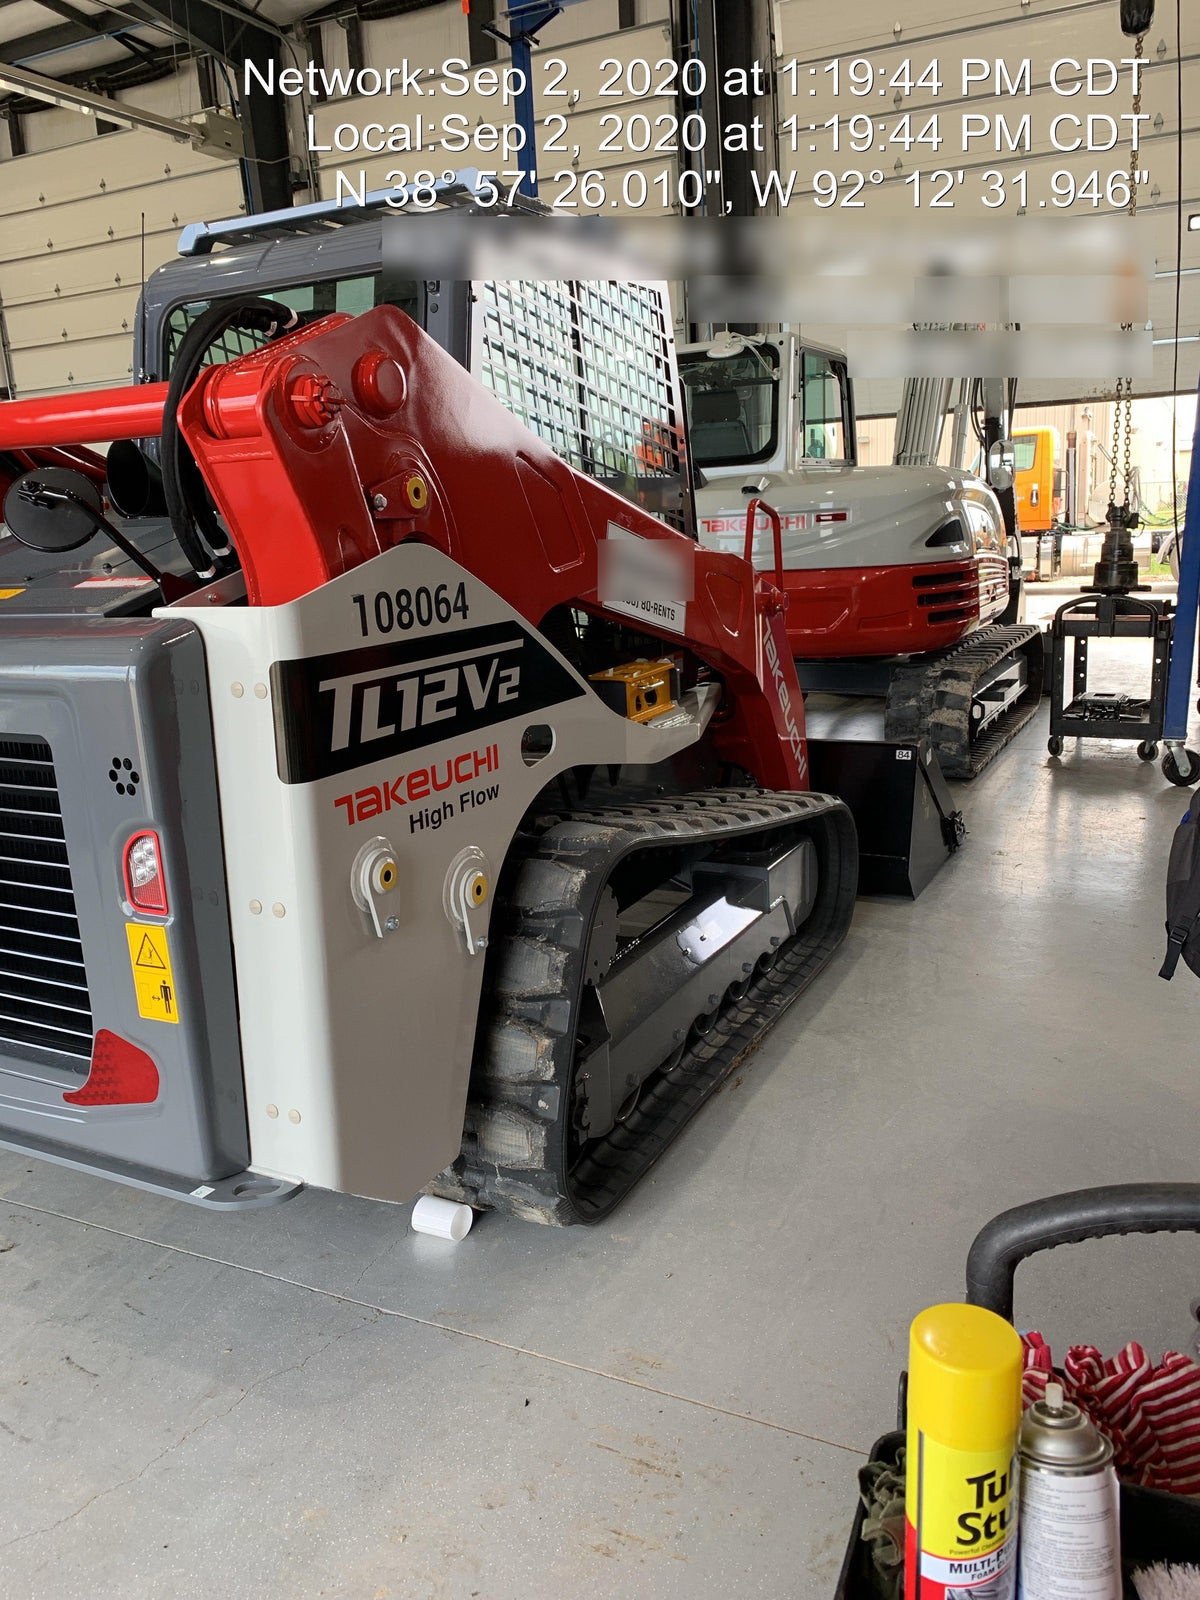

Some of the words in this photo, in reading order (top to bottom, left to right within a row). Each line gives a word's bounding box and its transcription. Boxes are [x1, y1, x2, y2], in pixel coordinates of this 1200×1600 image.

[352, 581, 470, 637] 108064
[640, 600, 676, 621] 80-RENTS
[762, 616, 807, 780] TAKEUCHI
[897, 750, 910, 759] 84
[334, 743, 500, 826] TAKEUCHI
[408, 800, 454, 834] High
[459, 784, 501, 813] Flow
[965, 1469, 1008, 1510] Tu
[956, 1504, 1011, 1547] Stu
